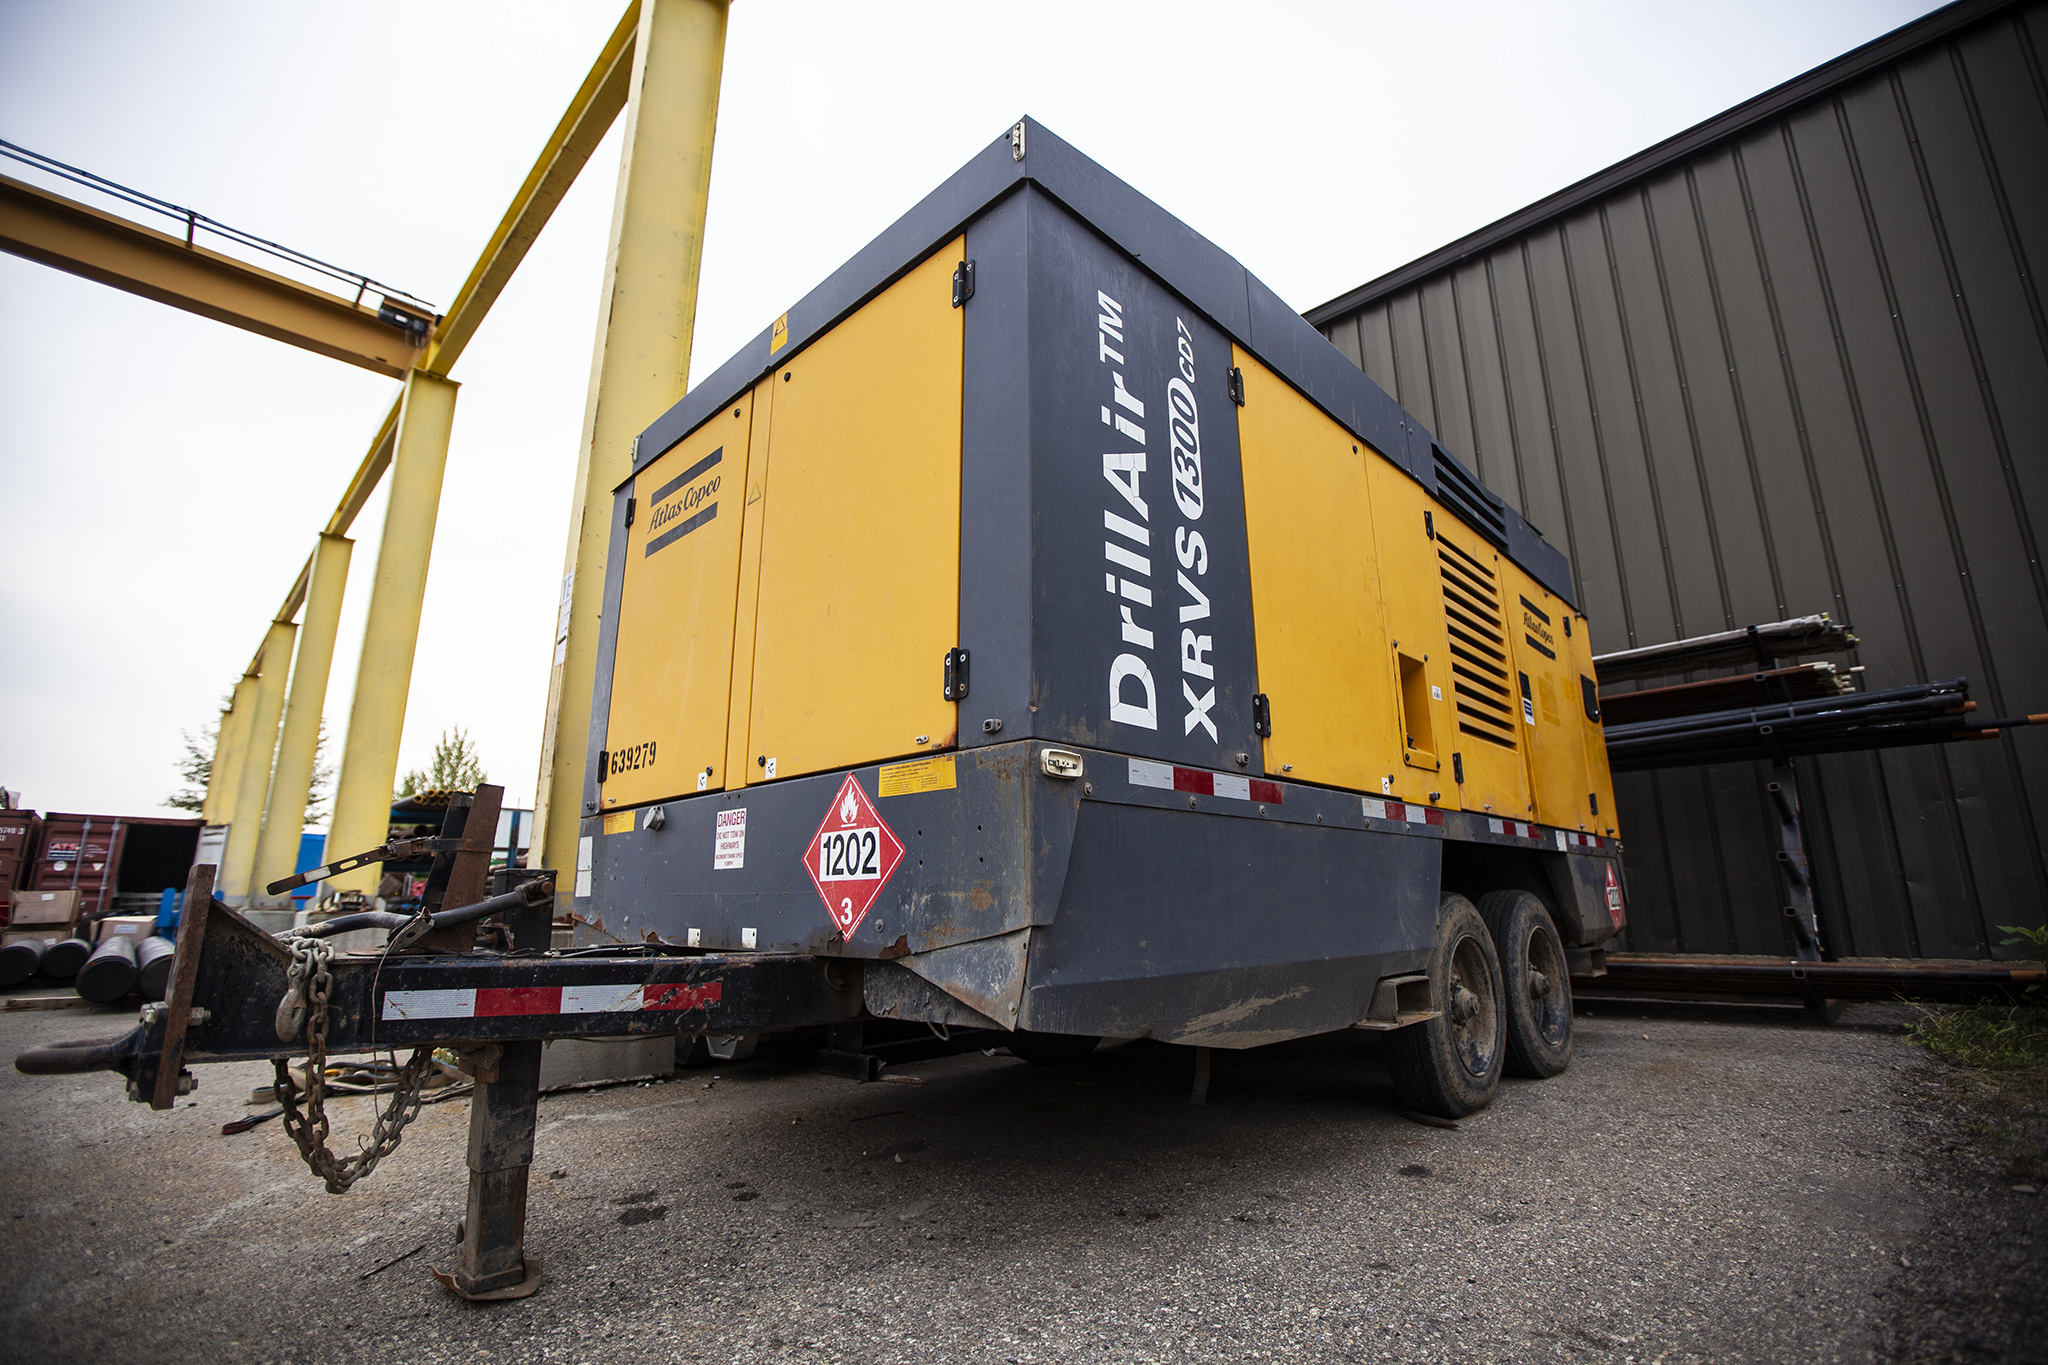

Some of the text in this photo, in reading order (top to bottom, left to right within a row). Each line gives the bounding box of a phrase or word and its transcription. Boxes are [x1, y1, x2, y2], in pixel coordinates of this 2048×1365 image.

[646, 475, 721, 535] Atlas Copco
[1170, 316, 1218, 745] XRVS 1300 CD7
[611, 740, 656, 776] 639279
[718, 810, 746, 828] DANGER
[823, 831, 877, 876] 1202
[840, 897, 853, 925] 3
